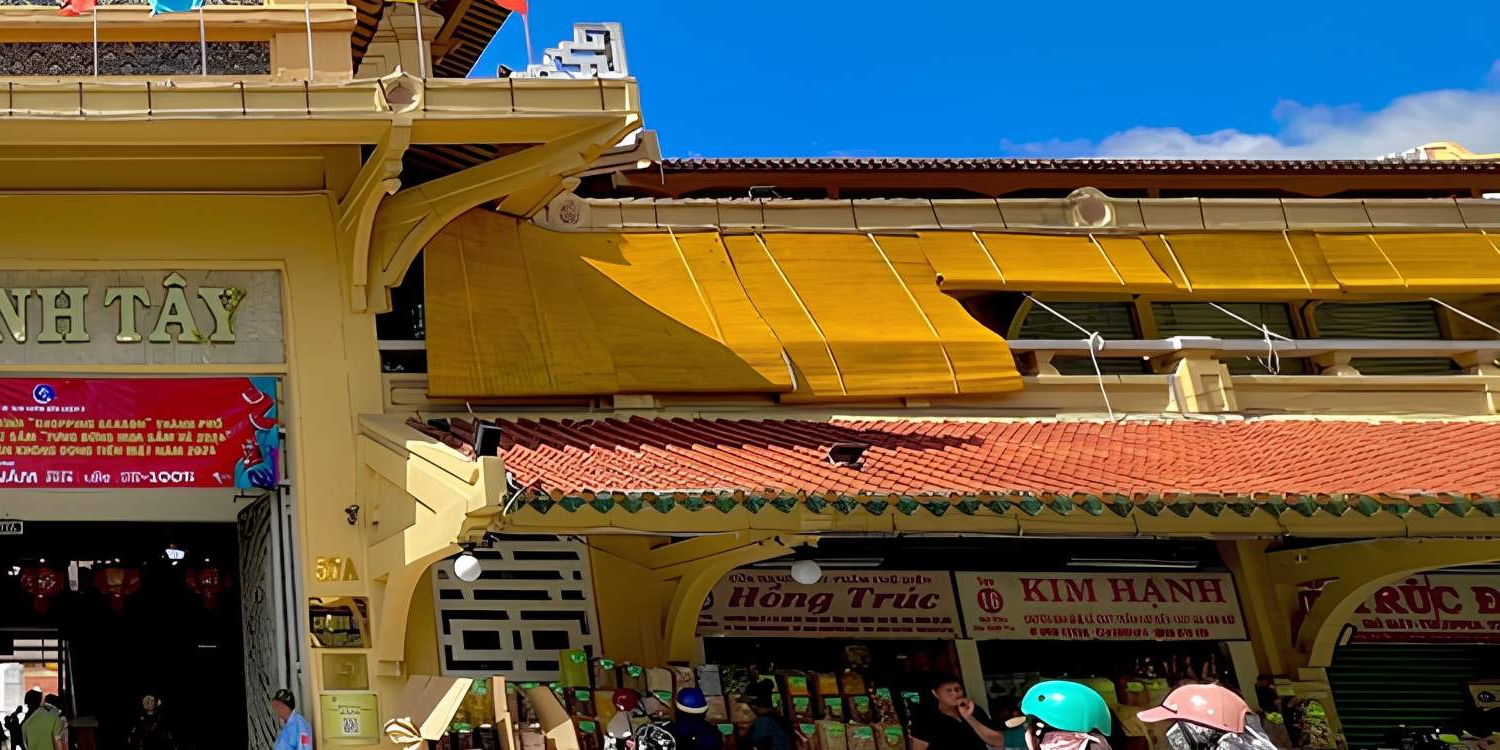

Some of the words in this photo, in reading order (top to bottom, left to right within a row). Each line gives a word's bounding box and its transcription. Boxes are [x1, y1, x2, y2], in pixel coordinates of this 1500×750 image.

[104, 272, 247, 344] TÂY
[728, 584, 835, 615] Hồng
[847, 587, 941, 610] Trúc
[1019, 578, 1099, 603] KIM
[1107, 578, 1227, 608] HẠNH
[1355, 578, 1463, 614] RÚC
